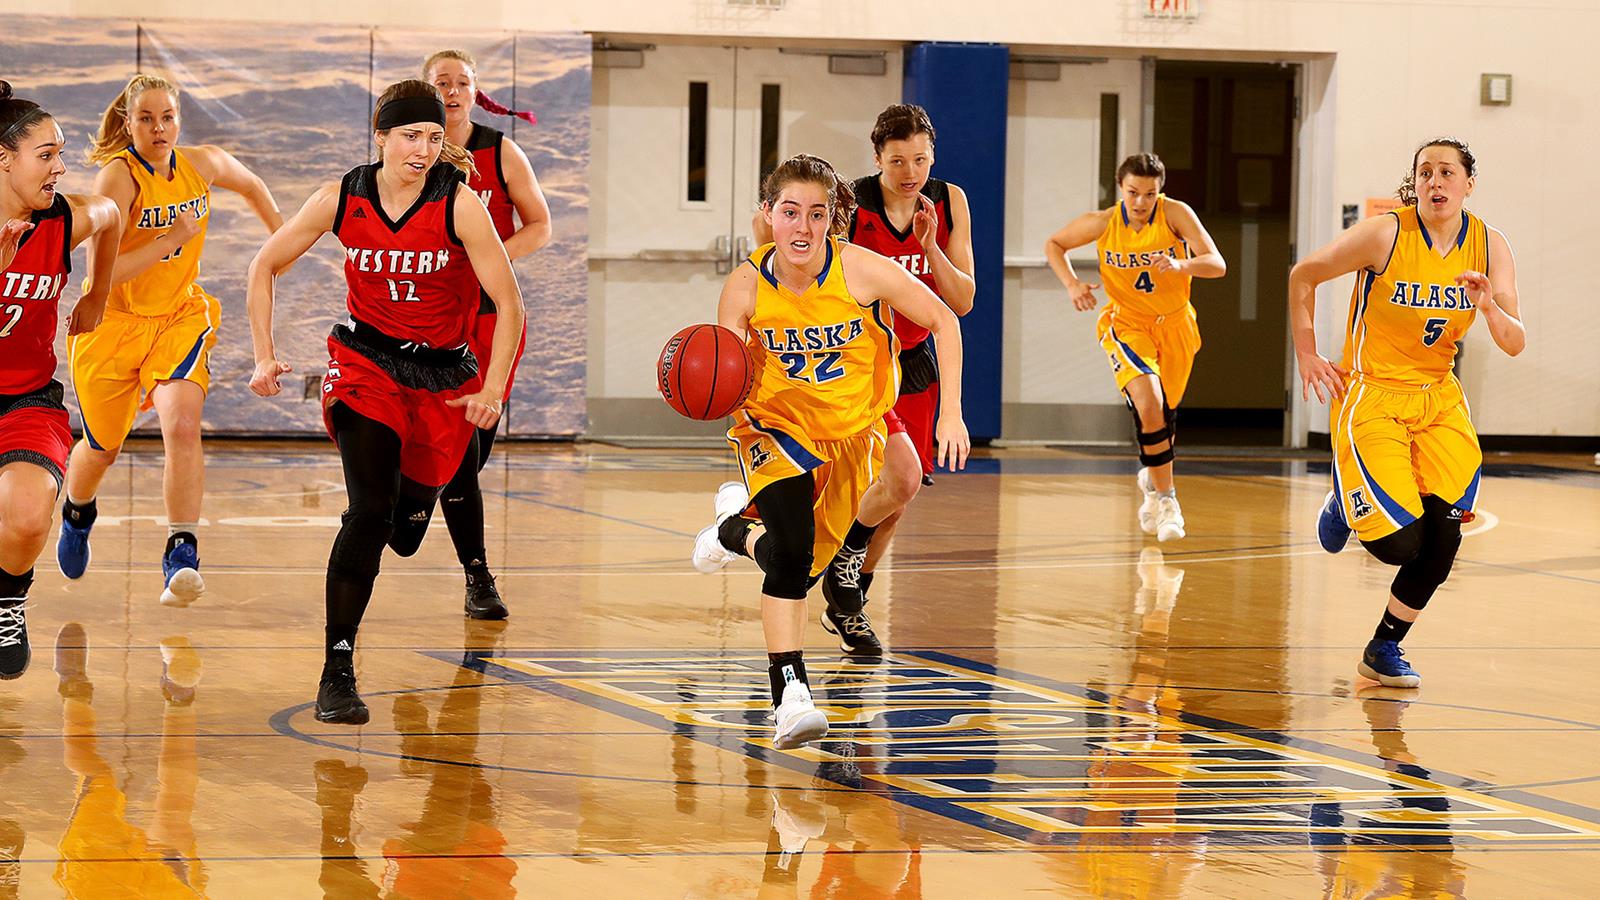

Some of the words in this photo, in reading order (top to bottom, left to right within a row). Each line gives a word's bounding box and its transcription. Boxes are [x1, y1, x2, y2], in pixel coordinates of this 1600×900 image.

[1104, 245, 1178, 268] ALASA
[2, 271, 62, 300] TERN
[385, 278, 421, 302] 12
[1134, 270, 1155, 293] 4
[1390, 280, 1476, 311] ALASK
[0, 303, 24, 338] 2
[754, 317, 864, 353] LASKA
[1422, 317, 1449, 347] 5
[778, 350, 846, 385] 22
